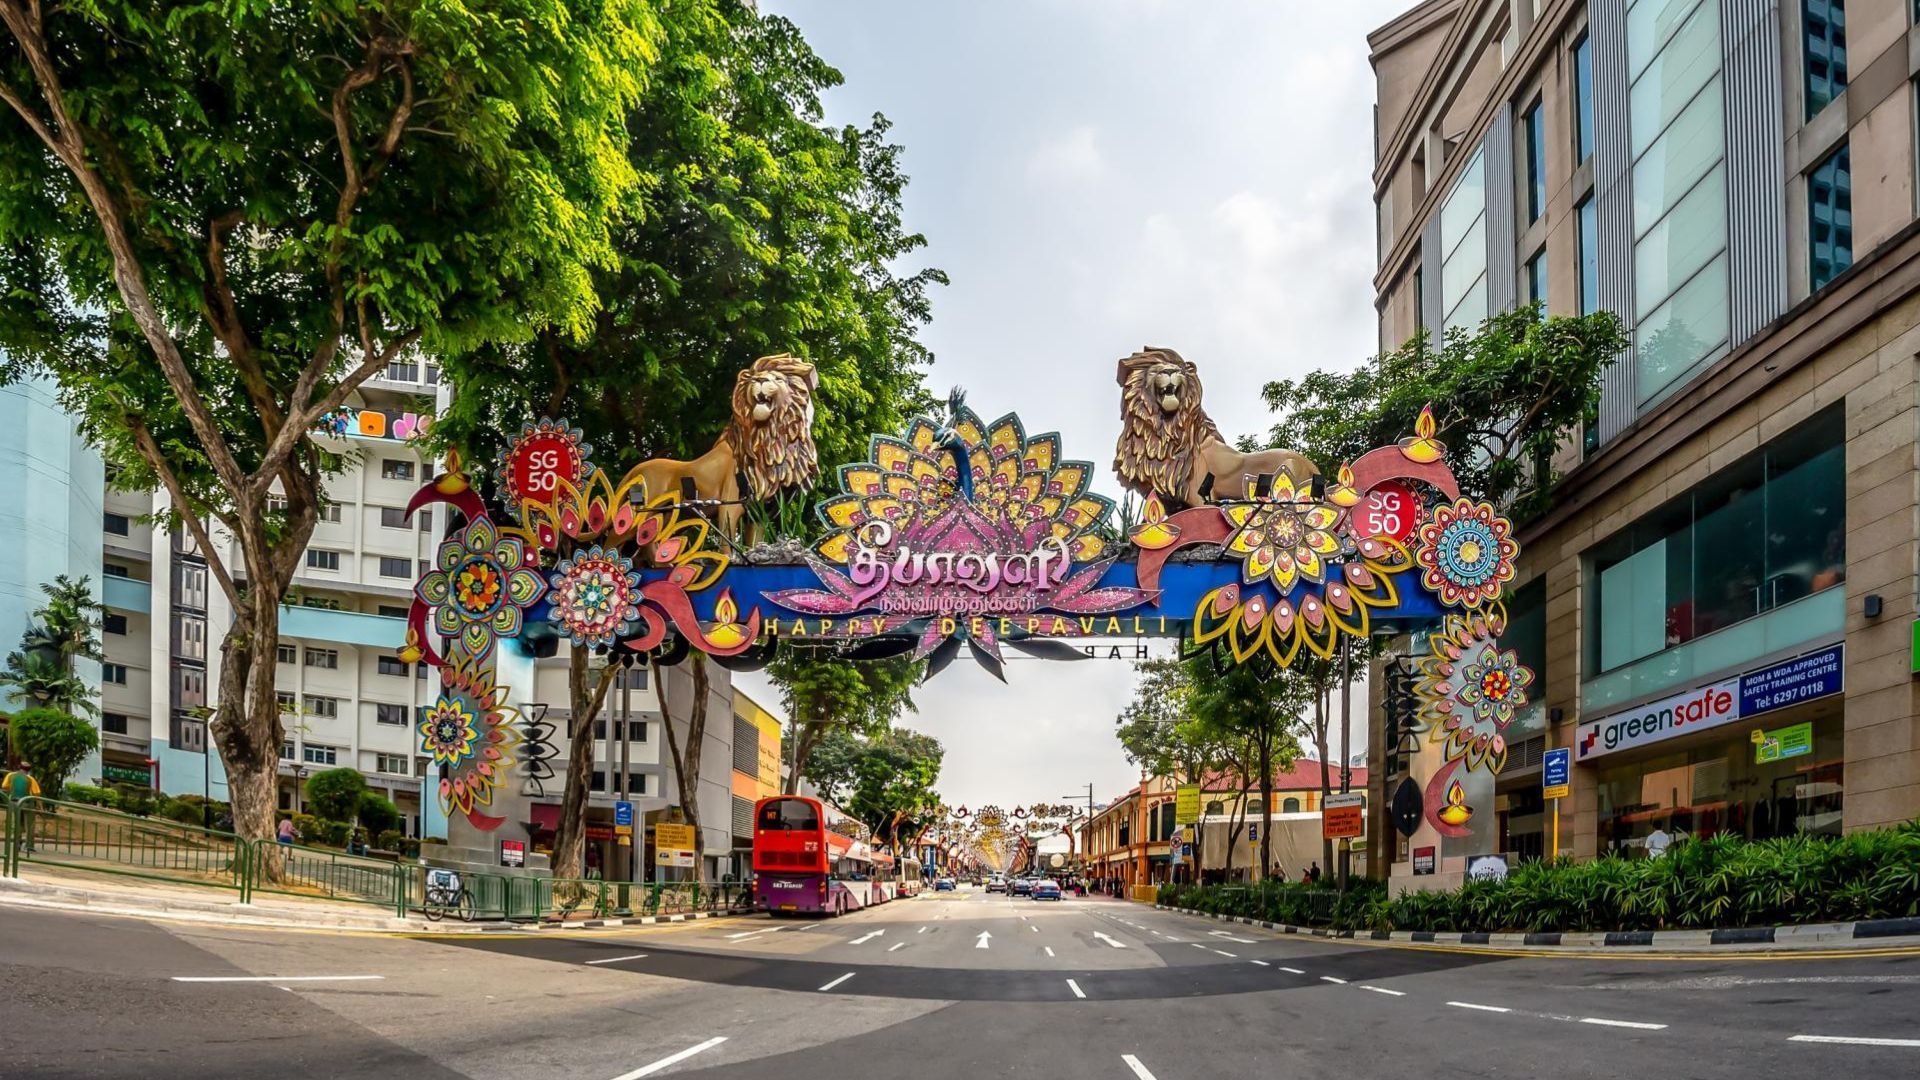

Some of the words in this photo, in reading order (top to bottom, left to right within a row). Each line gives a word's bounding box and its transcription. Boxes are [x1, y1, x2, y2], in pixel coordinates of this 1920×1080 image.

[528, 450, 558, 470] SG
[527, 471, 557, 492] 50
[1368, 490, 1401, 511] SG
[1368, 512, 1401, 535] 50
[850, 520, 1070, 609] தீபாவளி
[764, 618, 886, 636] HAPPY
[941, 615, 1165, 636] DEEPAVALI
[1743, 683, 1769, 697] SAFETY
[1771, 673, 1806, 689] TRAINING
[1807, 663, 1838, 678] CENTRE
[1745, 675, 1765, 687] MOM
[1766, 672, 1772, 680] &
[1773, 667, 1792, 678] WDA
[1793, 653, 1835, 672] APPROVED
[1773, 688, 1798, 704] 6297
[1800, 681, 1824, 697] 0118
[1604, 688, 1733, 750] greensafe
